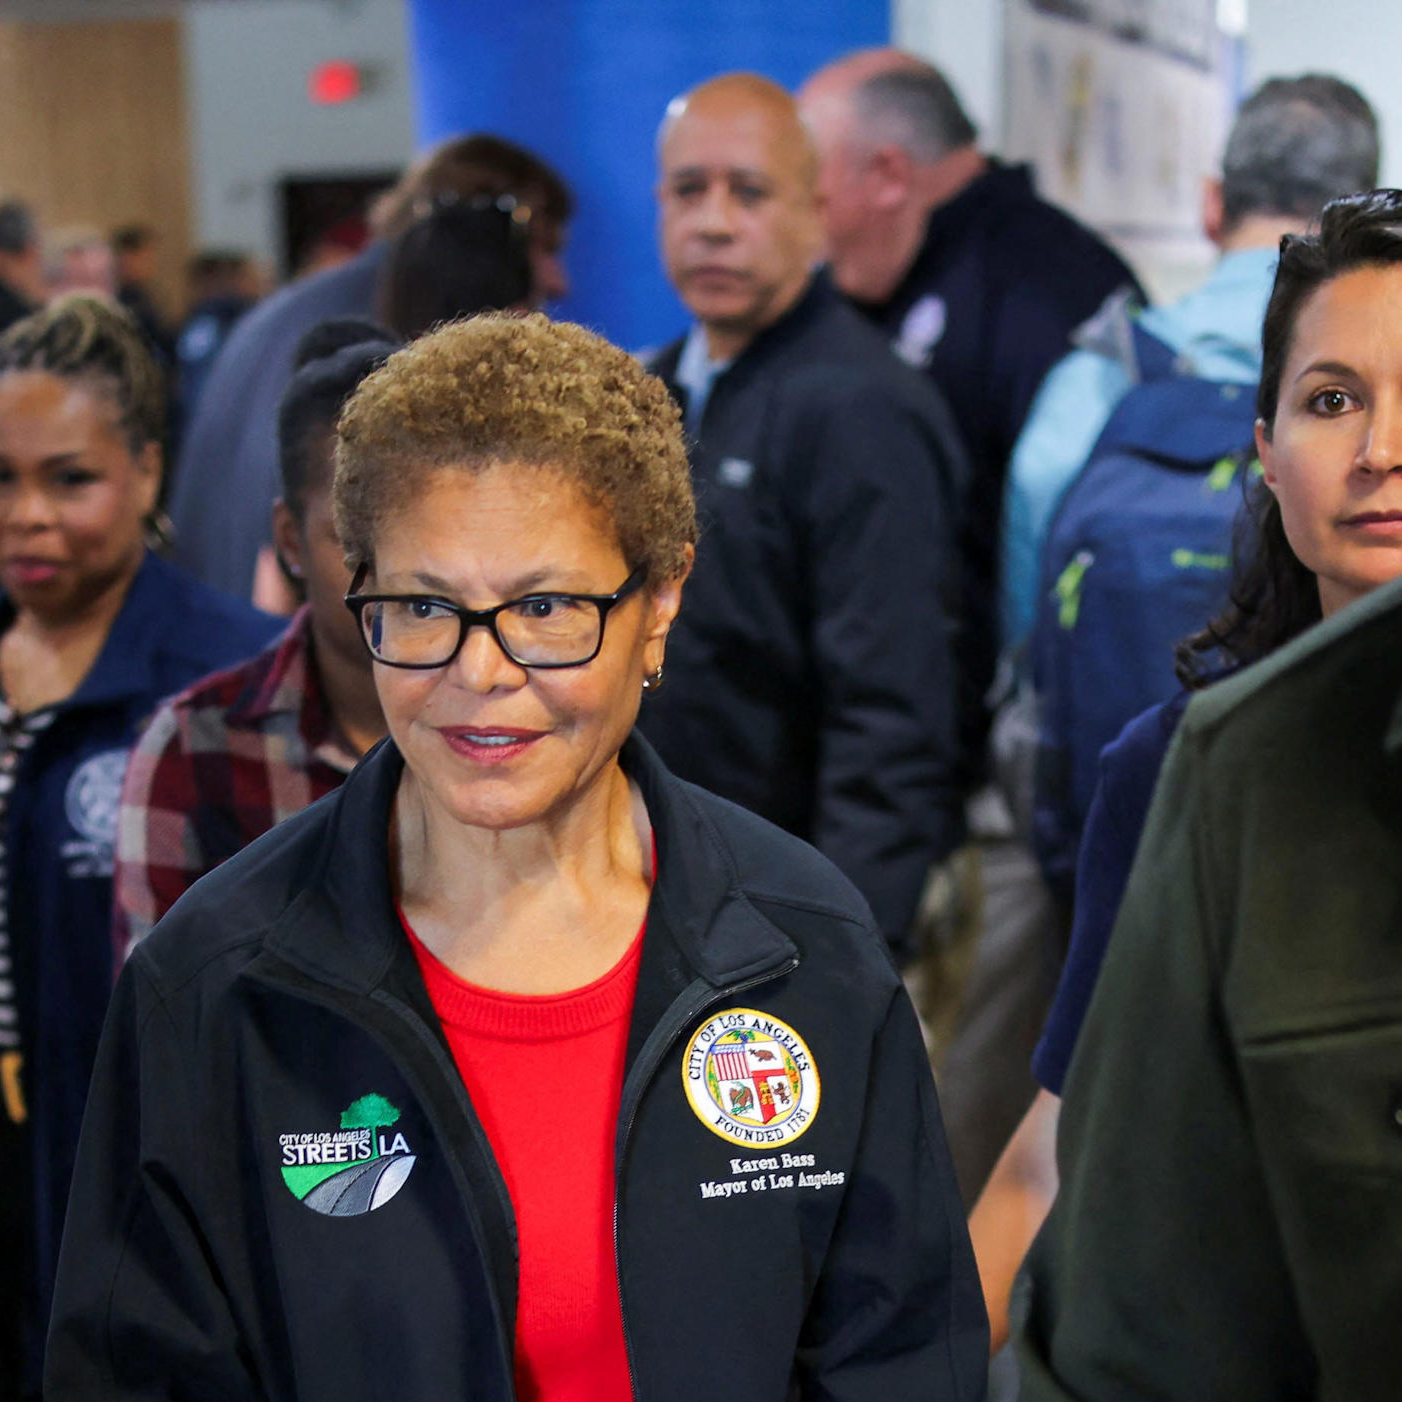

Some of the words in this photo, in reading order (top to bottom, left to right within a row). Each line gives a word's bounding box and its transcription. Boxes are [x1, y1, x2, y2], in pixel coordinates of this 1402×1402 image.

[689, 1045, 705, 1080] CITY
[700, 1024, 719, 1042] OF
[719, 1014, 746, 1028] LOS
[752, 1018, 810, 1073] ANGELES
[279, 1133, 299, 1146] CITY
[300, 1133, 313, 1144] OF
[313, 1132, 331, 1144] LOS
[333, 1129, 371, 1143] ANGELES
[715, 1115, 785, 1142] FOUNDED
[787, 1108, 810, 1134] 1781
[282, 1139, 372, 1165] STREETS
[379, 1132, 411, 1156] LA
[729, 1157, 780, 1175] Karen
[781, 1153, 815, 1169] Bass
[699, 1180, 748, 1199] Mayor
[751, 1175, 767, 1191] of
[768, 1173, 794, 1190] Los
[798, 1170, 846, 1190] Angeles
